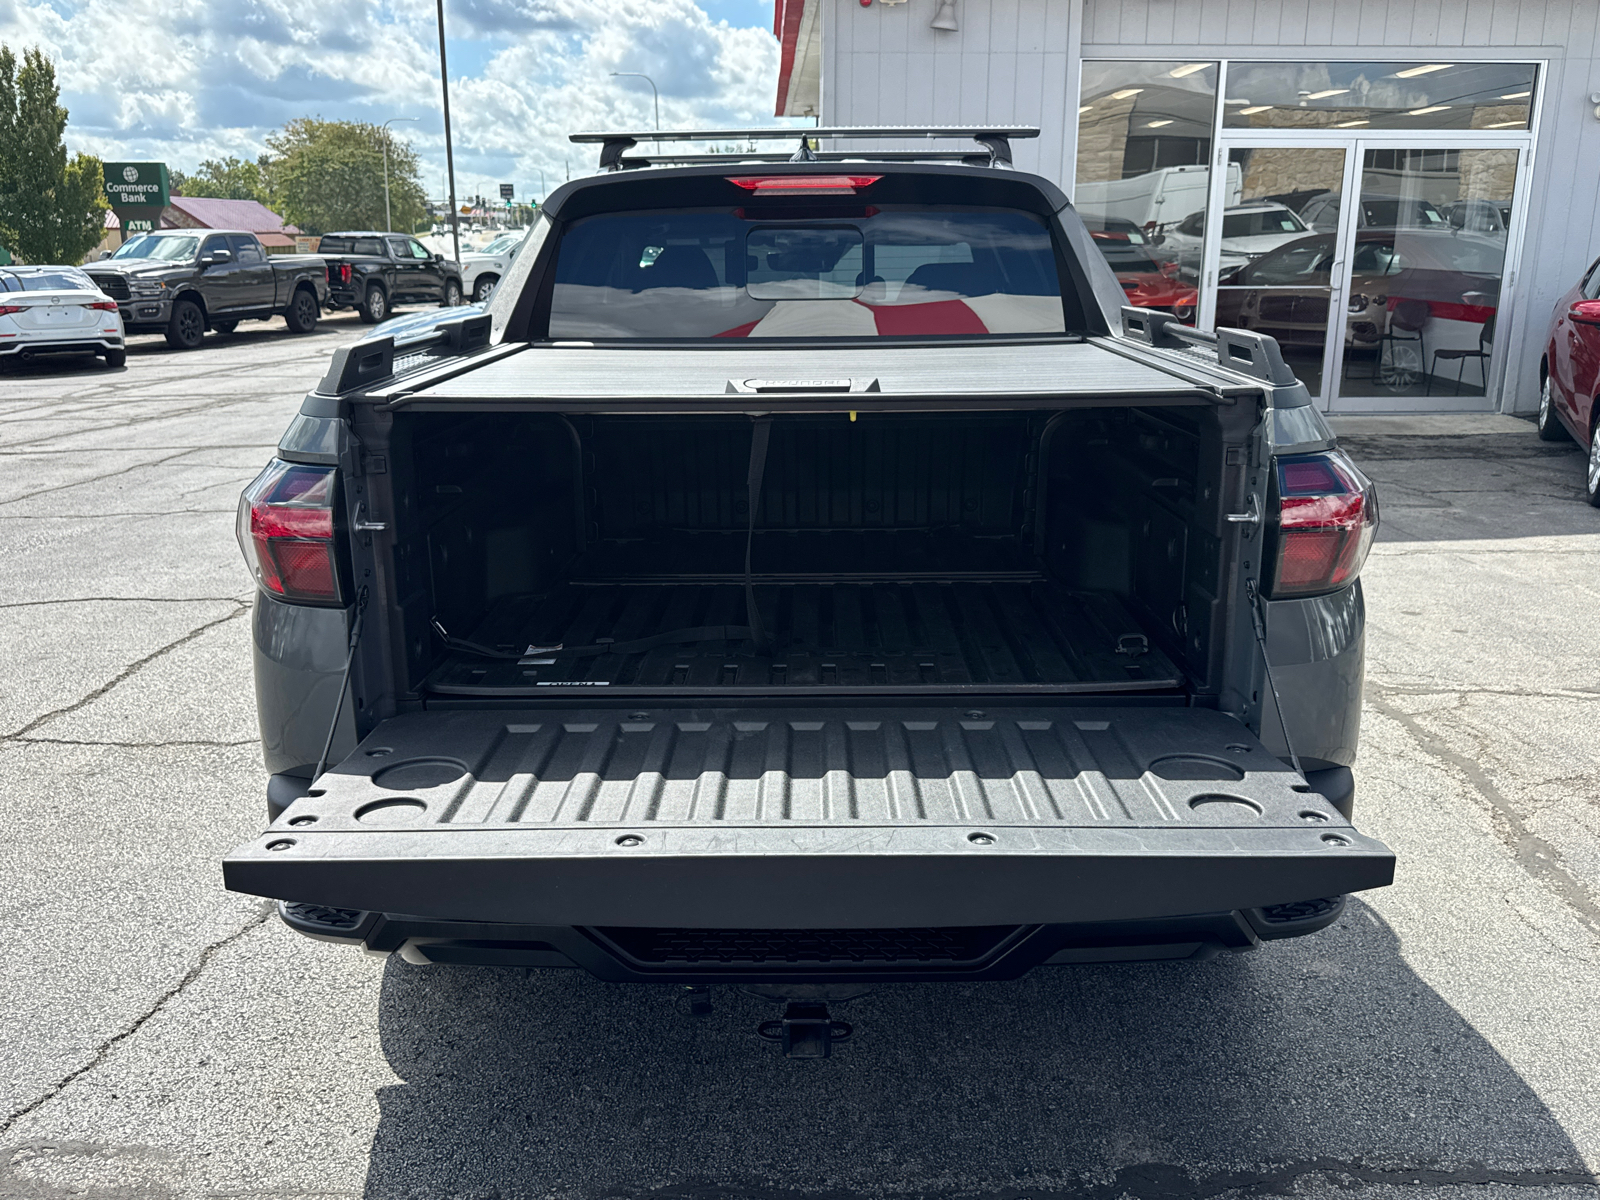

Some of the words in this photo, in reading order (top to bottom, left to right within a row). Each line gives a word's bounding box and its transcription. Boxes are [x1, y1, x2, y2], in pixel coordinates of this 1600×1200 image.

[106, 182, 159, 193] Commerce
[121, 193, 147, 203] Bank
[127, 220, 153, 231] ATM
